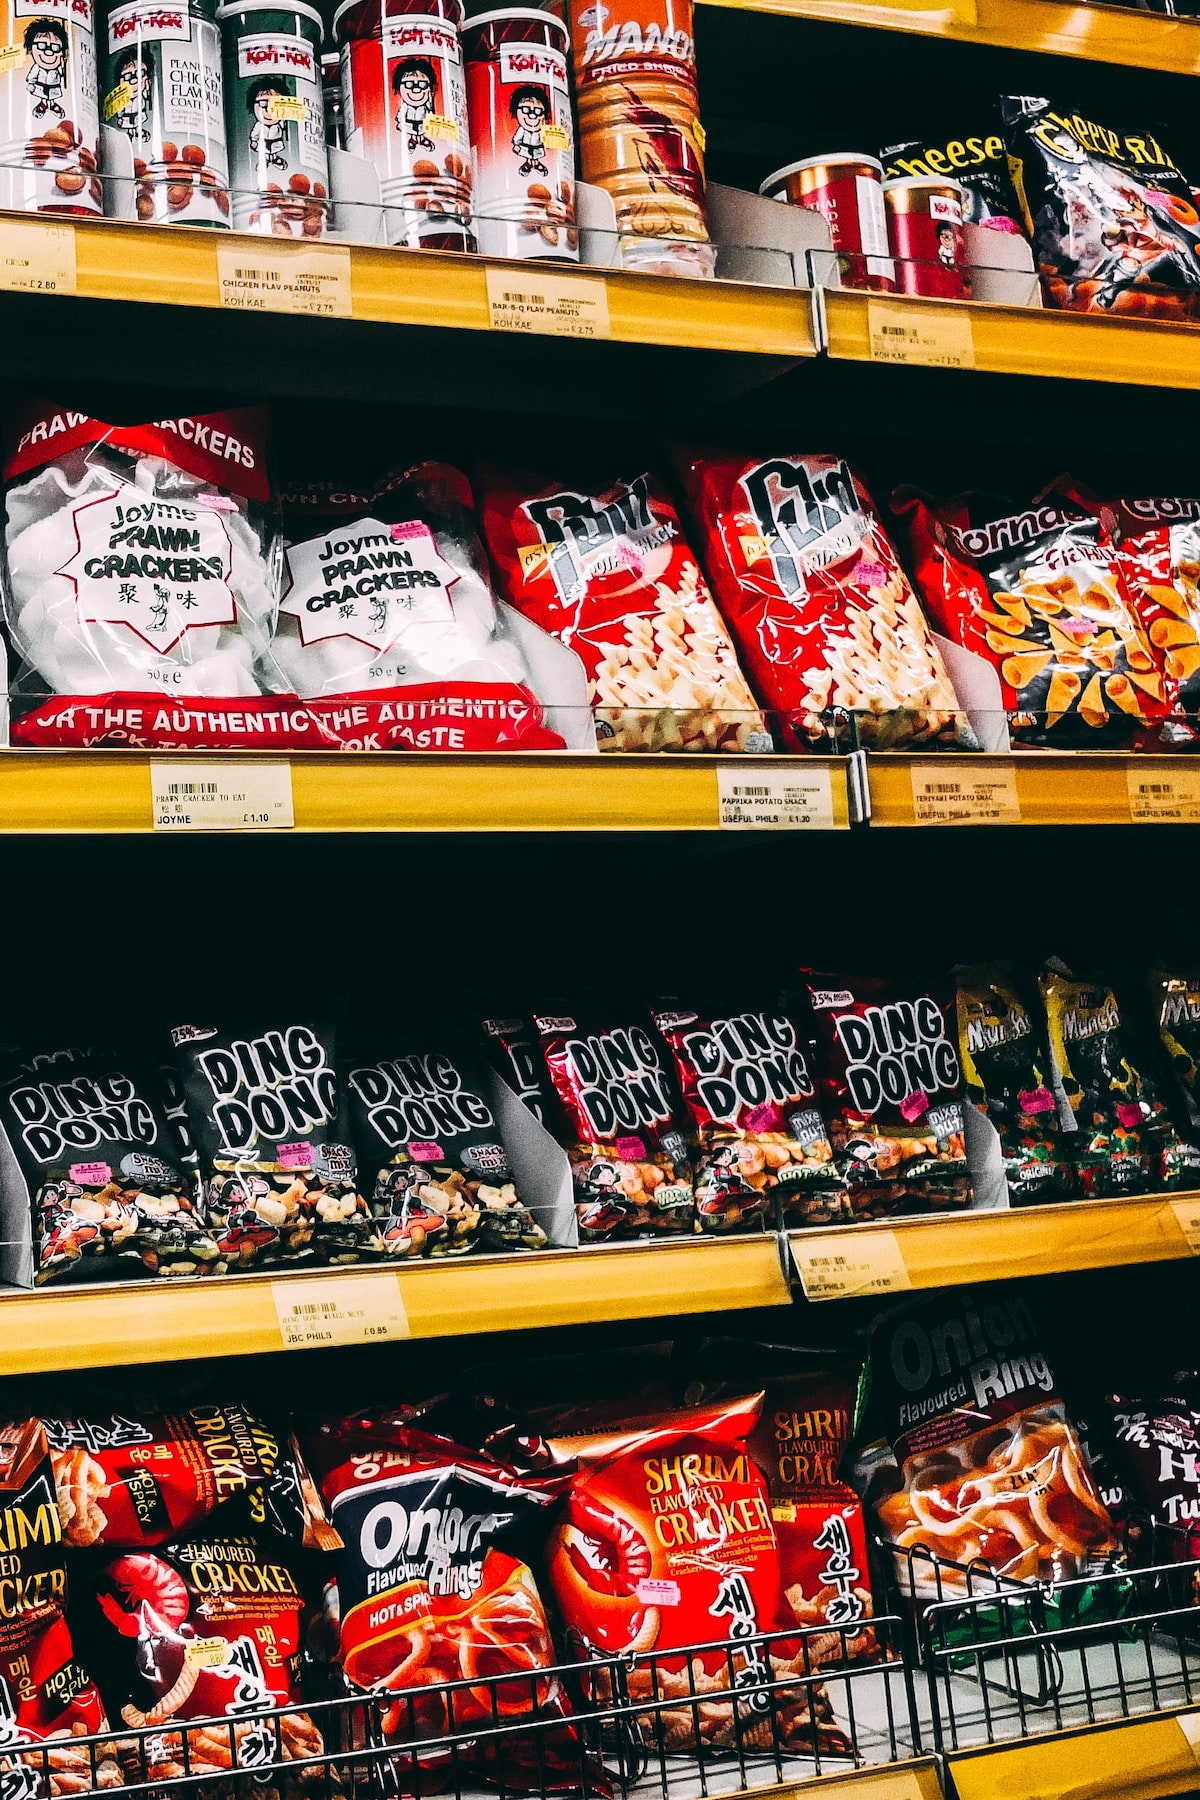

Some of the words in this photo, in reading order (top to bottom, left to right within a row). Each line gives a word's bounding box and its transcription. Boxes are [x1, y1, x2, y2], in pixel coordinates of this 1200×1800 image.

[886, 134, 1004, 179] heese
[223, 280, 259, 289] CHICKEN
[262, 282, 282, 291] FLAV
[283, 284, 321, 294] PEANUTS
[224, 297, 245, 306] KOH
[247, 299, 266, 308] KAE
[493, 319, 513, 329] KOH
[514, 321, 532, 330] KAE
[526, 305, 545, 314] FLAV
[546, 307, 580, 317] PEANUTS
[110, 501, 198, 530] Joyme
[108, 525, 201, 553] PRAWN
[84, 554, 224, 582] CRACKERS
[322, 551, 413, 587] PRAWN
[176, 589, 200, 610] 味
[306, 570, 441, 614] CRACKERS
[85, 708, 143, 730] THE
[152, 709, 309, 734] AUTHENTIC
[378, 697, 529, 724] AUTHENTIC
[388, 725, 465, 749] TASTE
[250, 813, 269, 822] 1.10
[722, 797, 753, 805] PAPRIKA
[722, 815, 754, 823] USEFUL
[157, 815, 192, 825] JOYME
[682, 1012, 797, 1077] DING
[837, 997, 945, 1064] DING
[200, 1026, 326, 1101] DING
[565, 1026, 660, 1087] DING
[349, 1053, 463, 1107] DING
[697, 1049, 815, 1123] DONG
[845, 1039, 961, 1115] DONG
[9, 1071, 136, 1125] DING
[22, 1099, 158, 1164] DONG
[367, 1091, 496, 1149] DONG
[329, 1157, 352, 1171] mix
[287, 1334, 303, 1343] JBC
[306, 1331, 332, 1341] PHILS
[899, 1382, 968, 1428] Flavoured
[188, 1404, 248, 1504] CRACKE
[126, 1478, 152, 1524] SPICY
[131, 1468, 158, 1499] HOT
[360, 1492, 490, 1569] Onion
[427, 1557, 484, 1600] Rings
[254, 1624, 285, 1668] 매운
[8, 1653, 38, 1703] 매운
[44, 1664, 74, 1699] HOT
